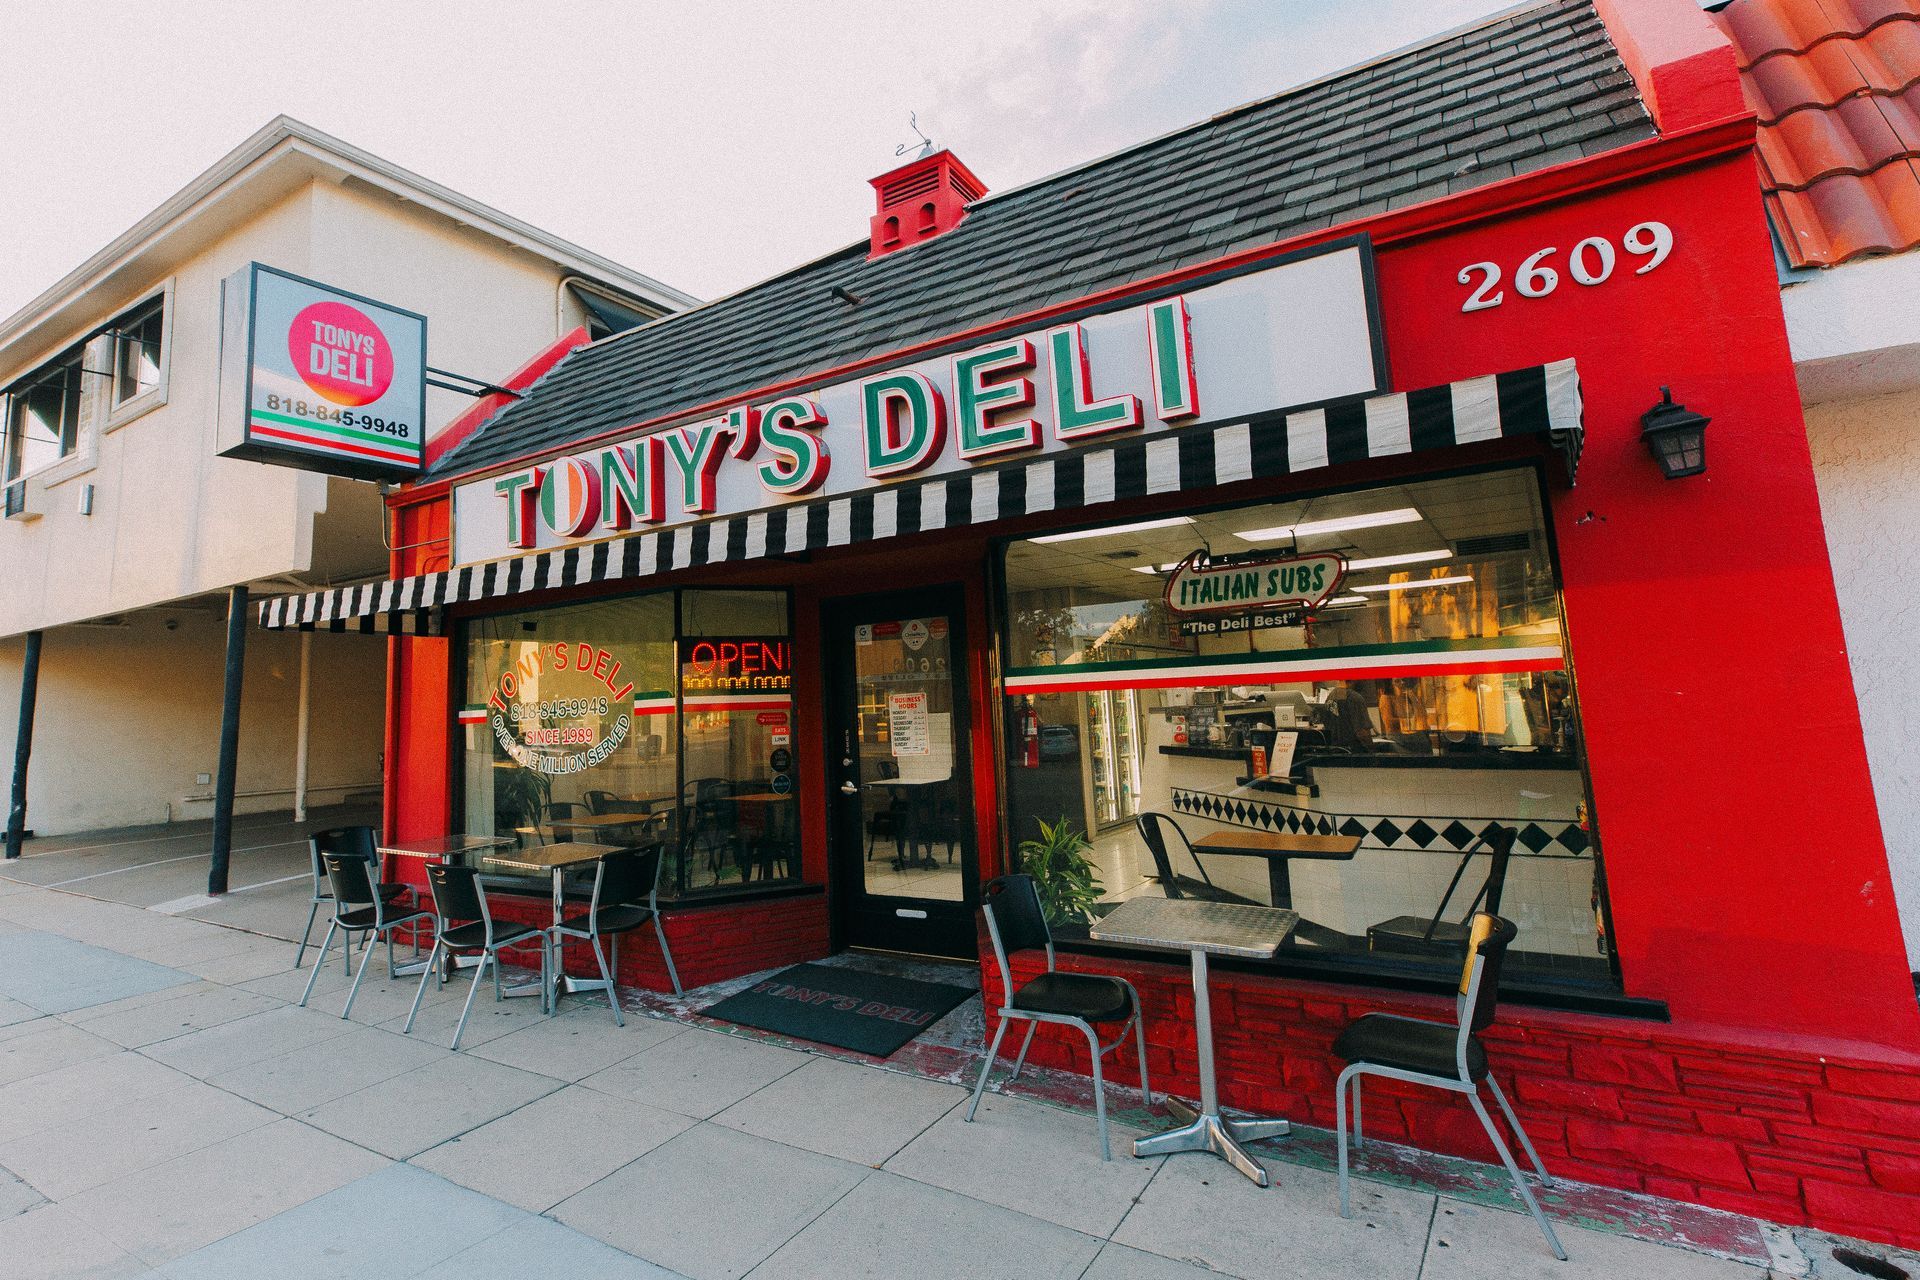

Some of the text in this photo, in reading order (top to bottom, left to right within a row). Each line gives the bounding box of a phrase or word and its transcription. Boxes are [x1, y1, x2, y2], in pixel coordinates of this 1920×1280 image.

[1458, 221, 1674, 313] 2609
[311, 320, 375, 356] TONYS
[310, 342, 373, 387] DELI
[266, 393, 409, 438] 818-845-9948
[494, 295, 1200, 549] TONY’S DELI
[1181, 563, 1326, 605] ITALIAN SUBS
[1221, 616, 1249, 630] Deli
[488, 642, 634, 712] TONY'S DELI
[511, 697, 608, 721] 818-845-9948
[492, 714, 516, 756] OVER
[538, 752, 587, 775] MILLION
[586, 713, 631, 766] SERVED
[526, 727, 594, 746] SINCE 1989
[752, 981, 937, 1026] TONY'S DELI
